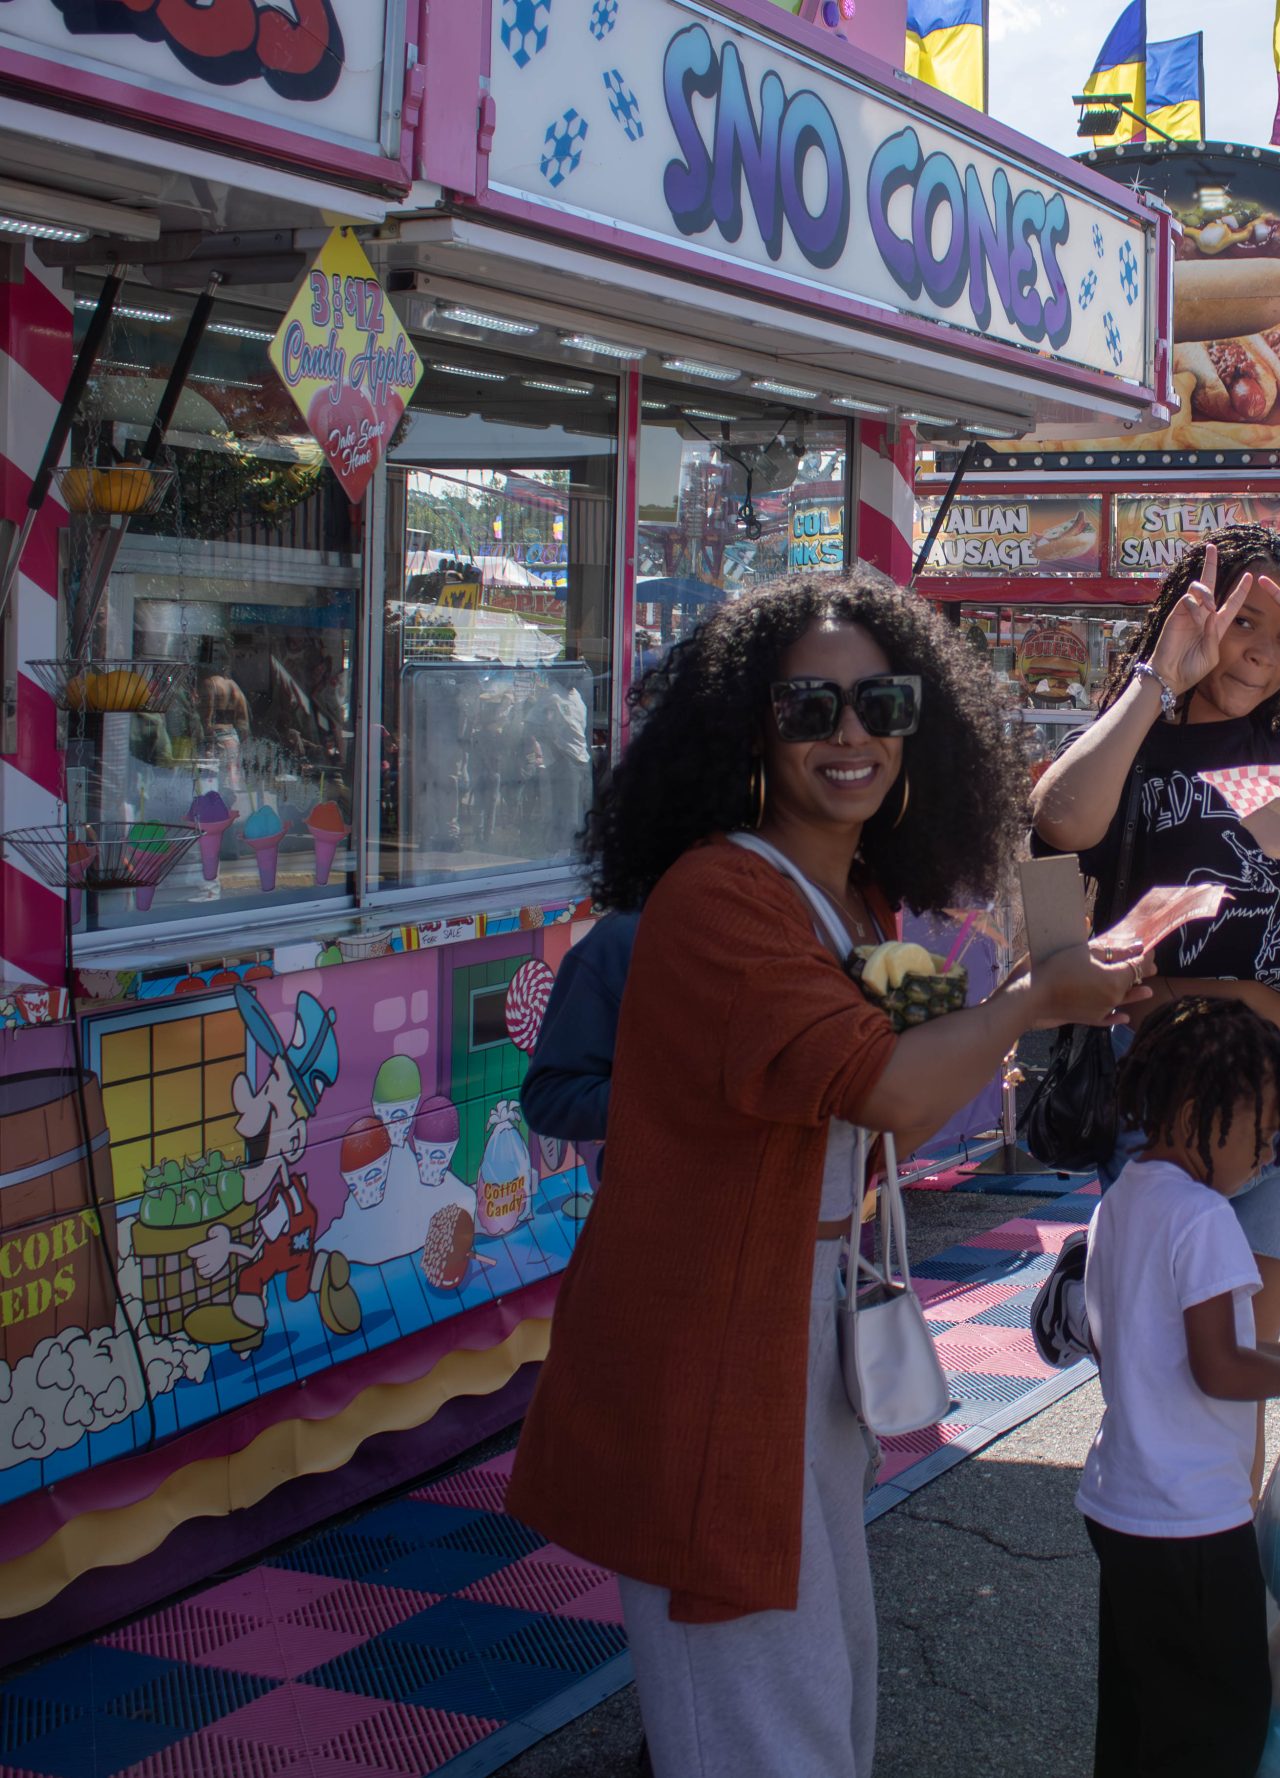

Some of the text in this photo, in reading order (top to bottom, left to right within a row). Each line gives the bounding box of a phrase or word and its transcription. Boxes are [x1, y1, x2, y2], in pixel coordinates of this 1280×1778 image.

[663, 21, 1073, 351] SNO CONES
[310, 270, 384, 333] 3 FOR $12
[282, 320, 416, 406] Candy Apples
[328, 419, 385, 457] Take Some
[341, 448, 371, 476] Home
[794, 510, 844, 538] COL
[1142, 504, 1240, 532] STEAK
[913, 538, 1040, 569] SAUSAGE
[483, 1176, 525, 1200] Cotton
[486, 1195, 523, 1218] Candy
[0, 1264, 76, 1327] EDS
